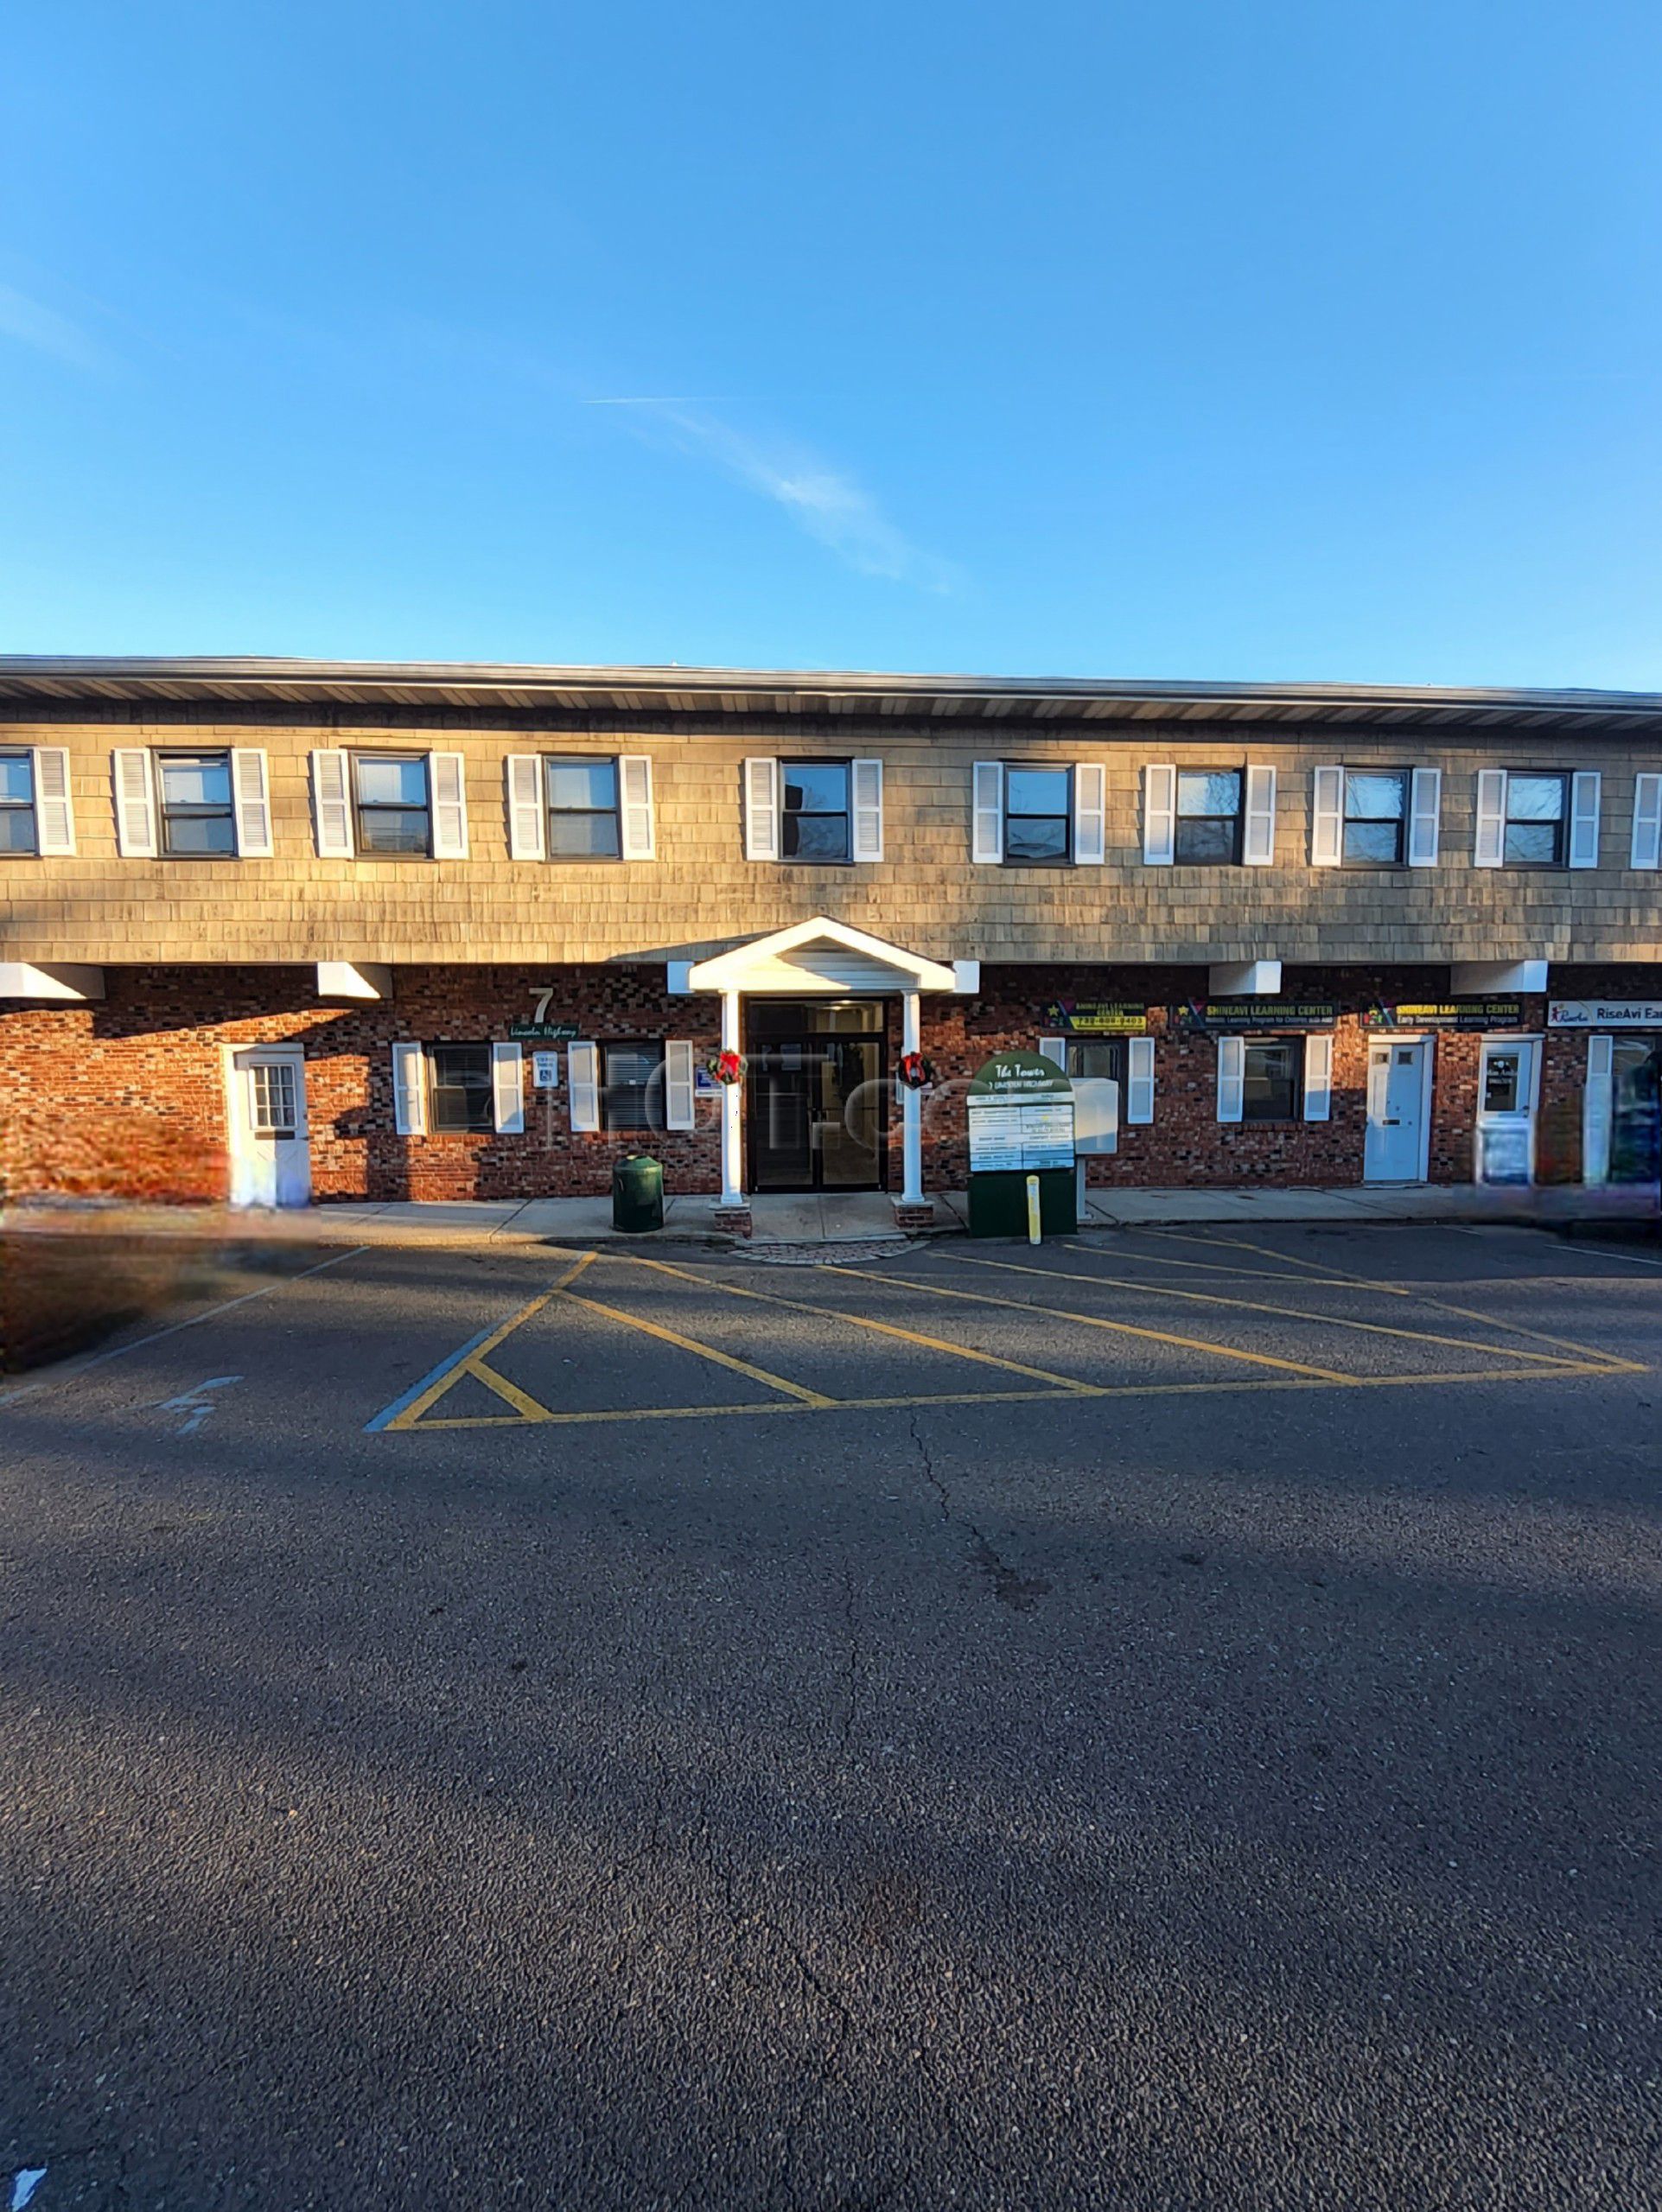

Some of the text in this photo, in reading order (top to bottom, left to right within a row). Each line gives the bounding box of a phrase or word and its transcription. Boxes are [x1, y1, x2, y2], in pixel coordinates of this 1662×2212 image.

[528, 987, 554, 1023] 7
[1251, 1005, 1296, 1016] LEARNING
[1297, 1005, 1334, 1016] CENTER
[1439, 1004, 1484, 1014] LEARNING
[1486, 1004, 1520, 1014] CENTER
[1596, 1007, 1642, 1020] RiseAvi
[510, 1026, 577, 1039] Lincoln Highway
[996, 1064, 1012, 1078] The
